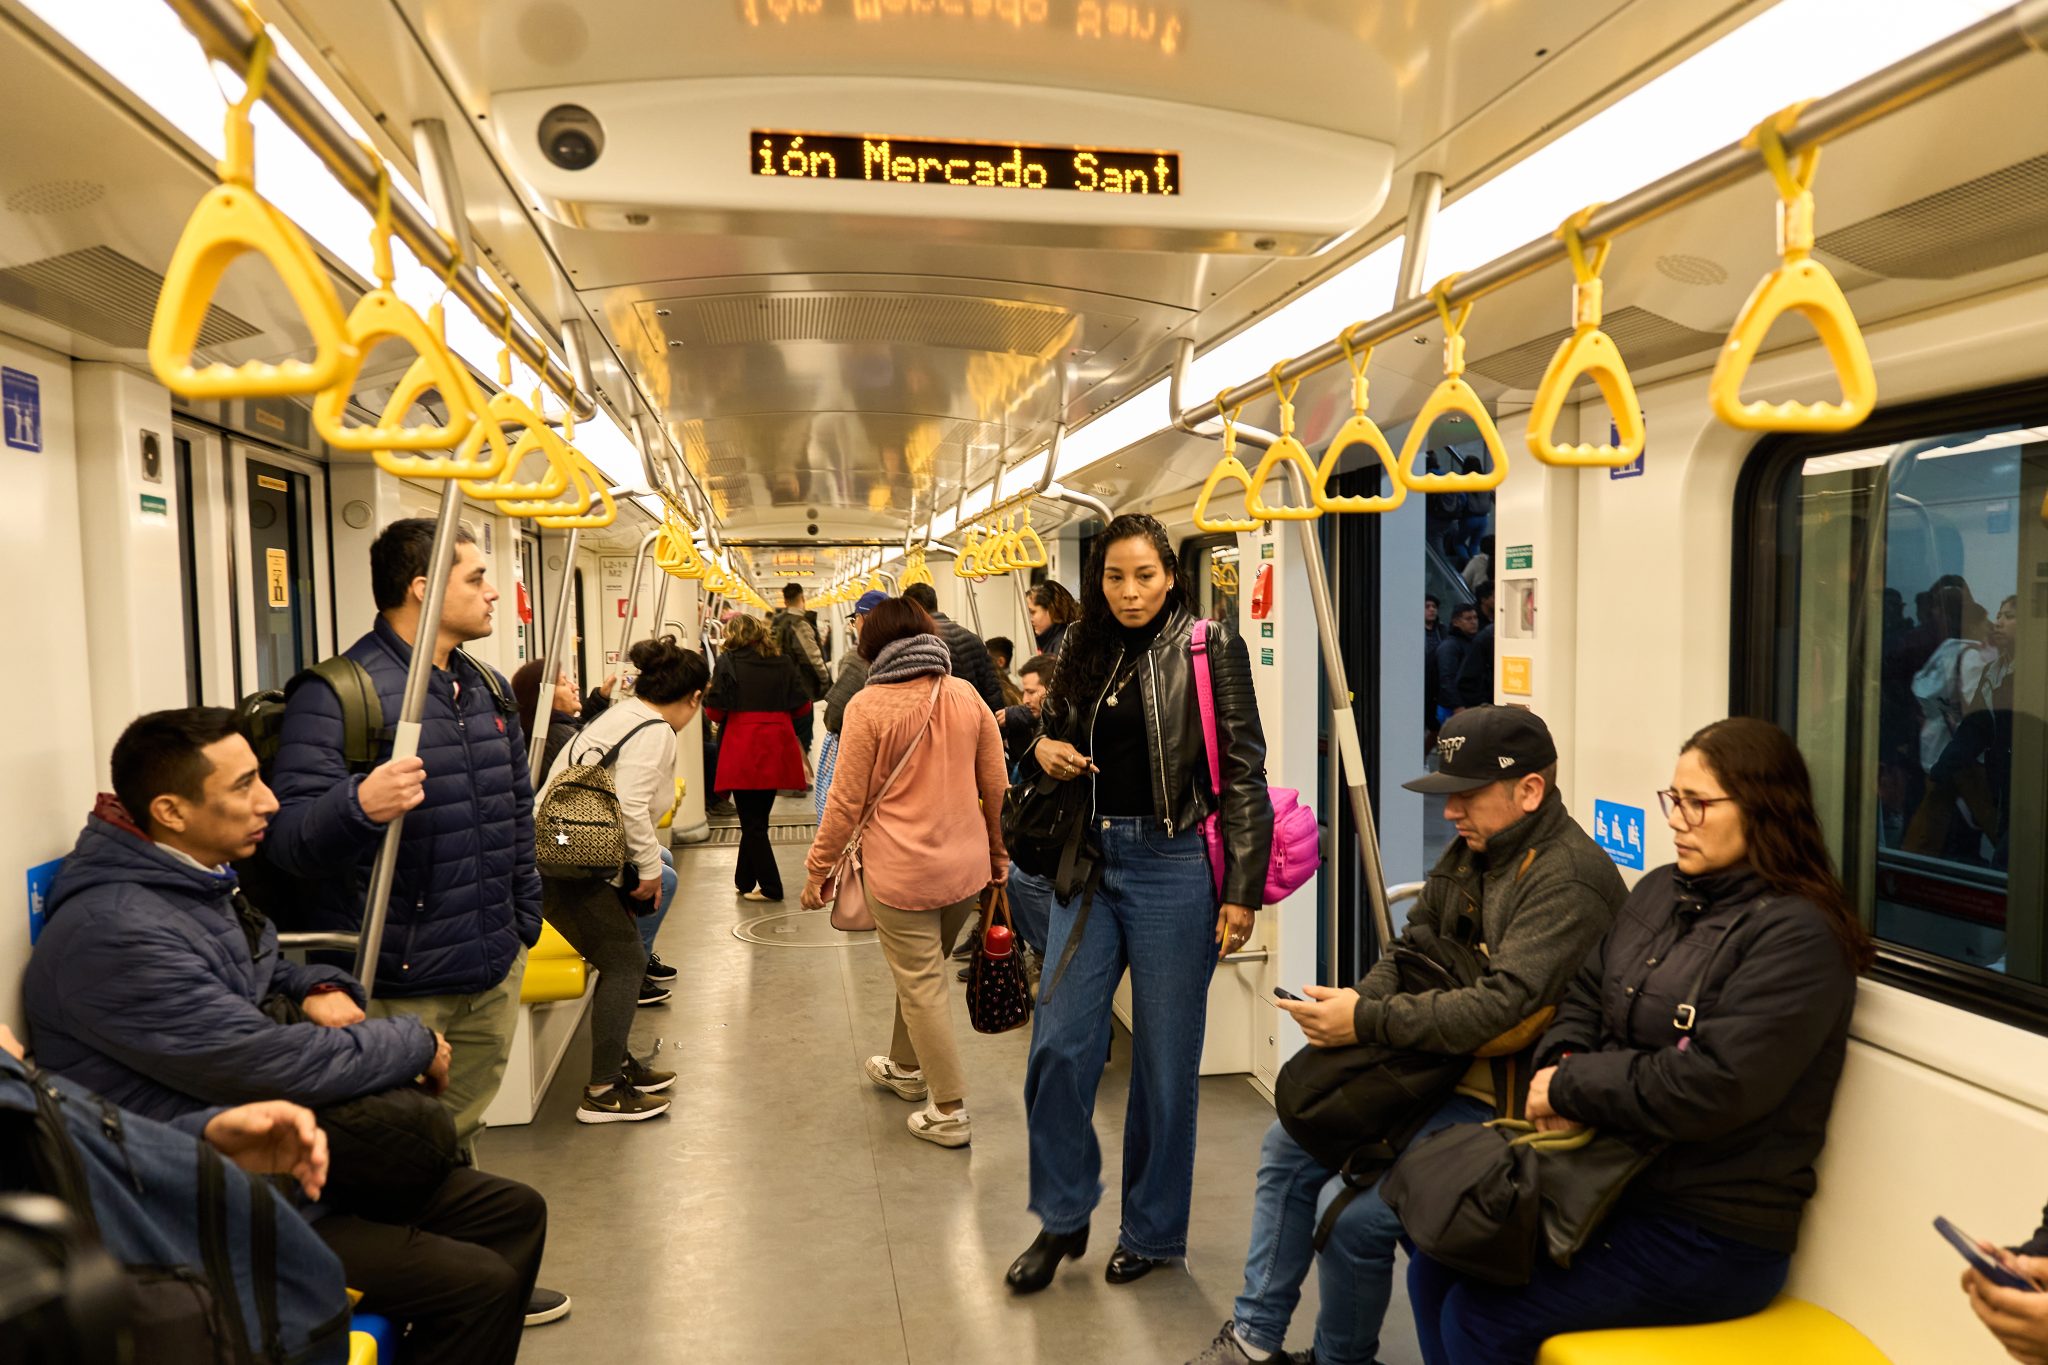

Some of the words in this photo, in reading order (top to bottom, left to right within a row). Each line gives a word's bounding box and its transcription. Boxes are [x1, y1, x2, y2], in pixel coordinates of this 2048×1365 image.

[758, 136, 837, 178] ión
[863, 140, 1048, 189] Mercado
[1073, 152, 1173, 196] Sant
